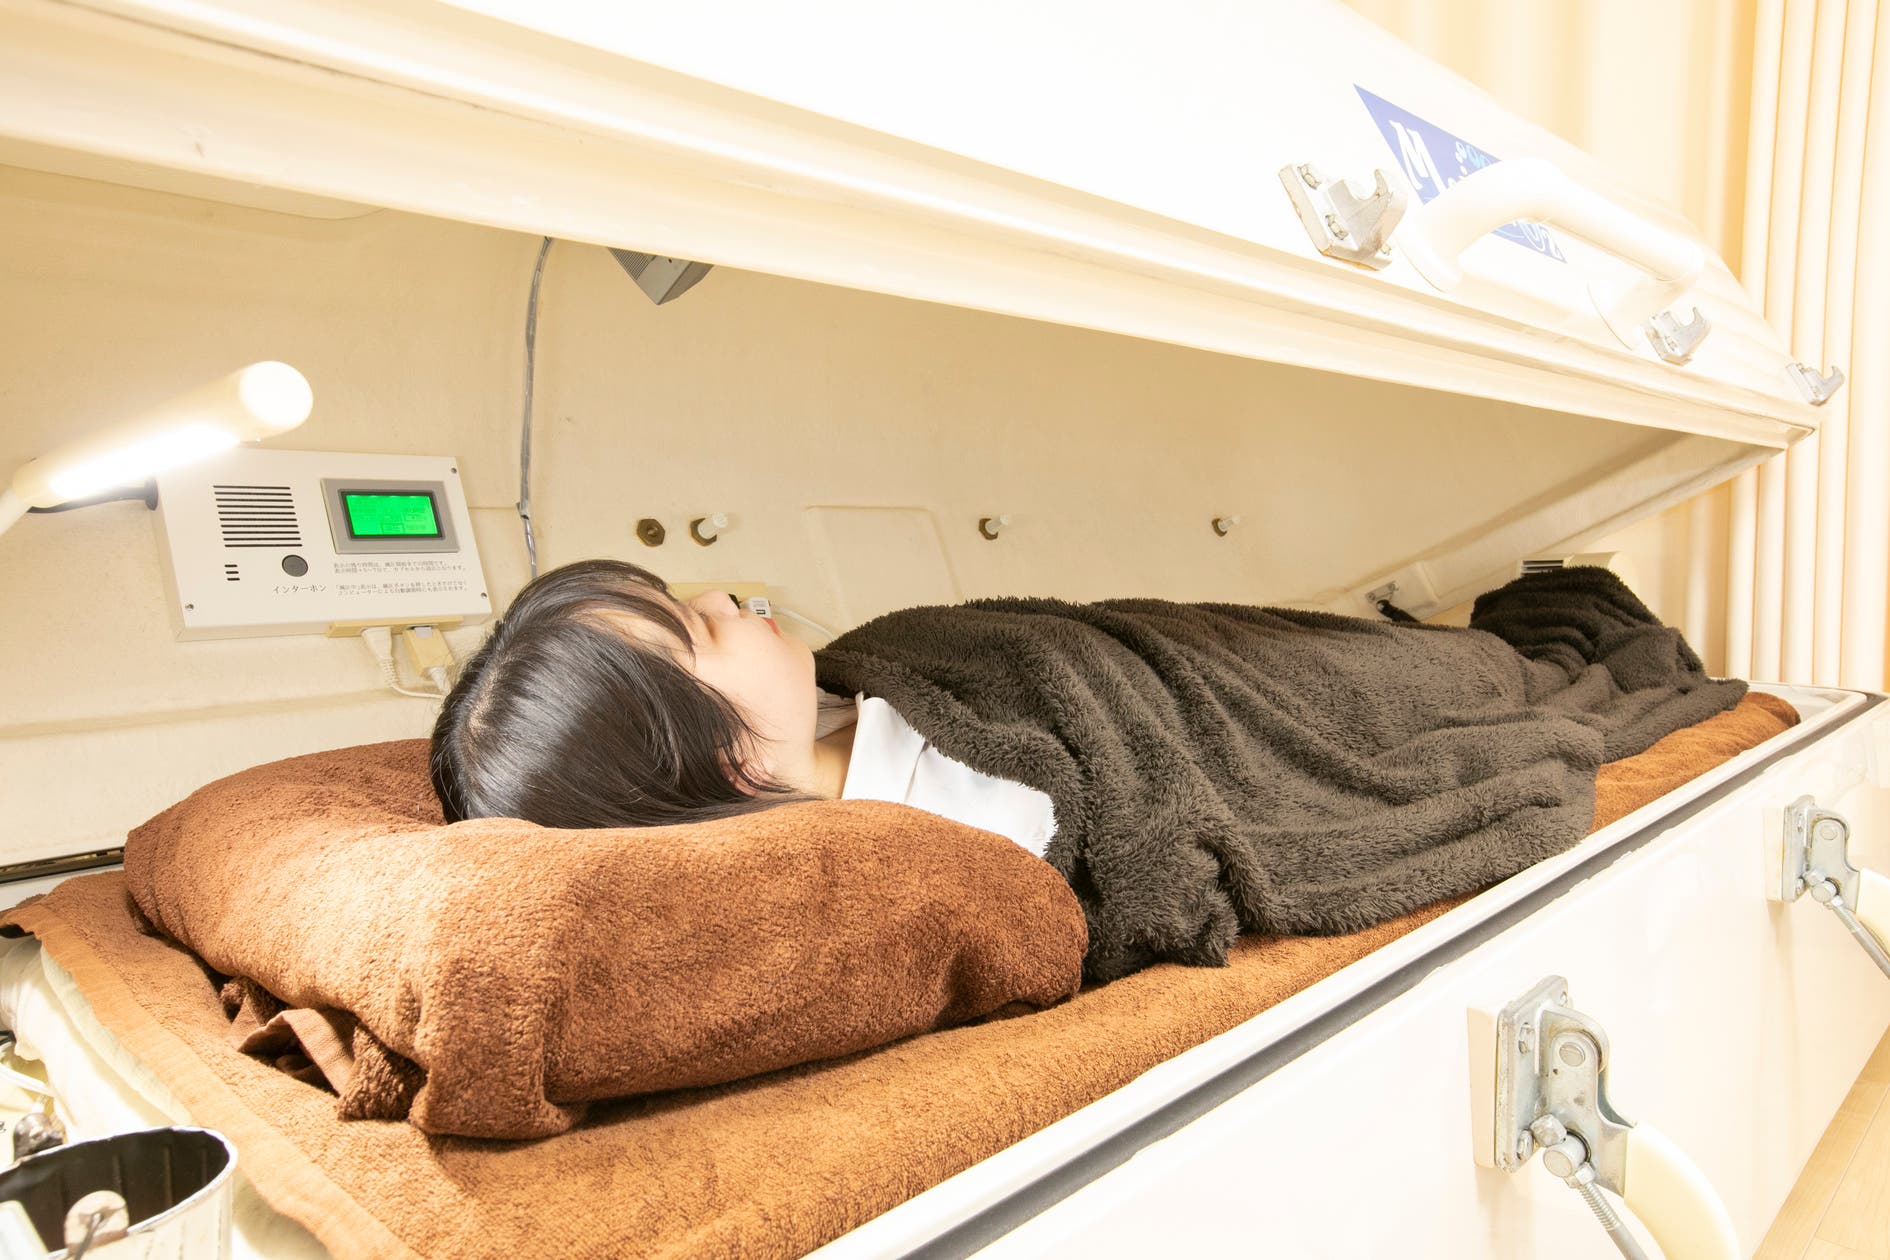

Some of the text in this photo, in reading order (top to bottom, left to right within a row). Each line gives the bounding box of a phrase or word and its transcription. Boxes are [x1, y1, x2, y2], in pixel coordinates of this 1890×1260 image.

[272, 584, 327, 595] インターホン
